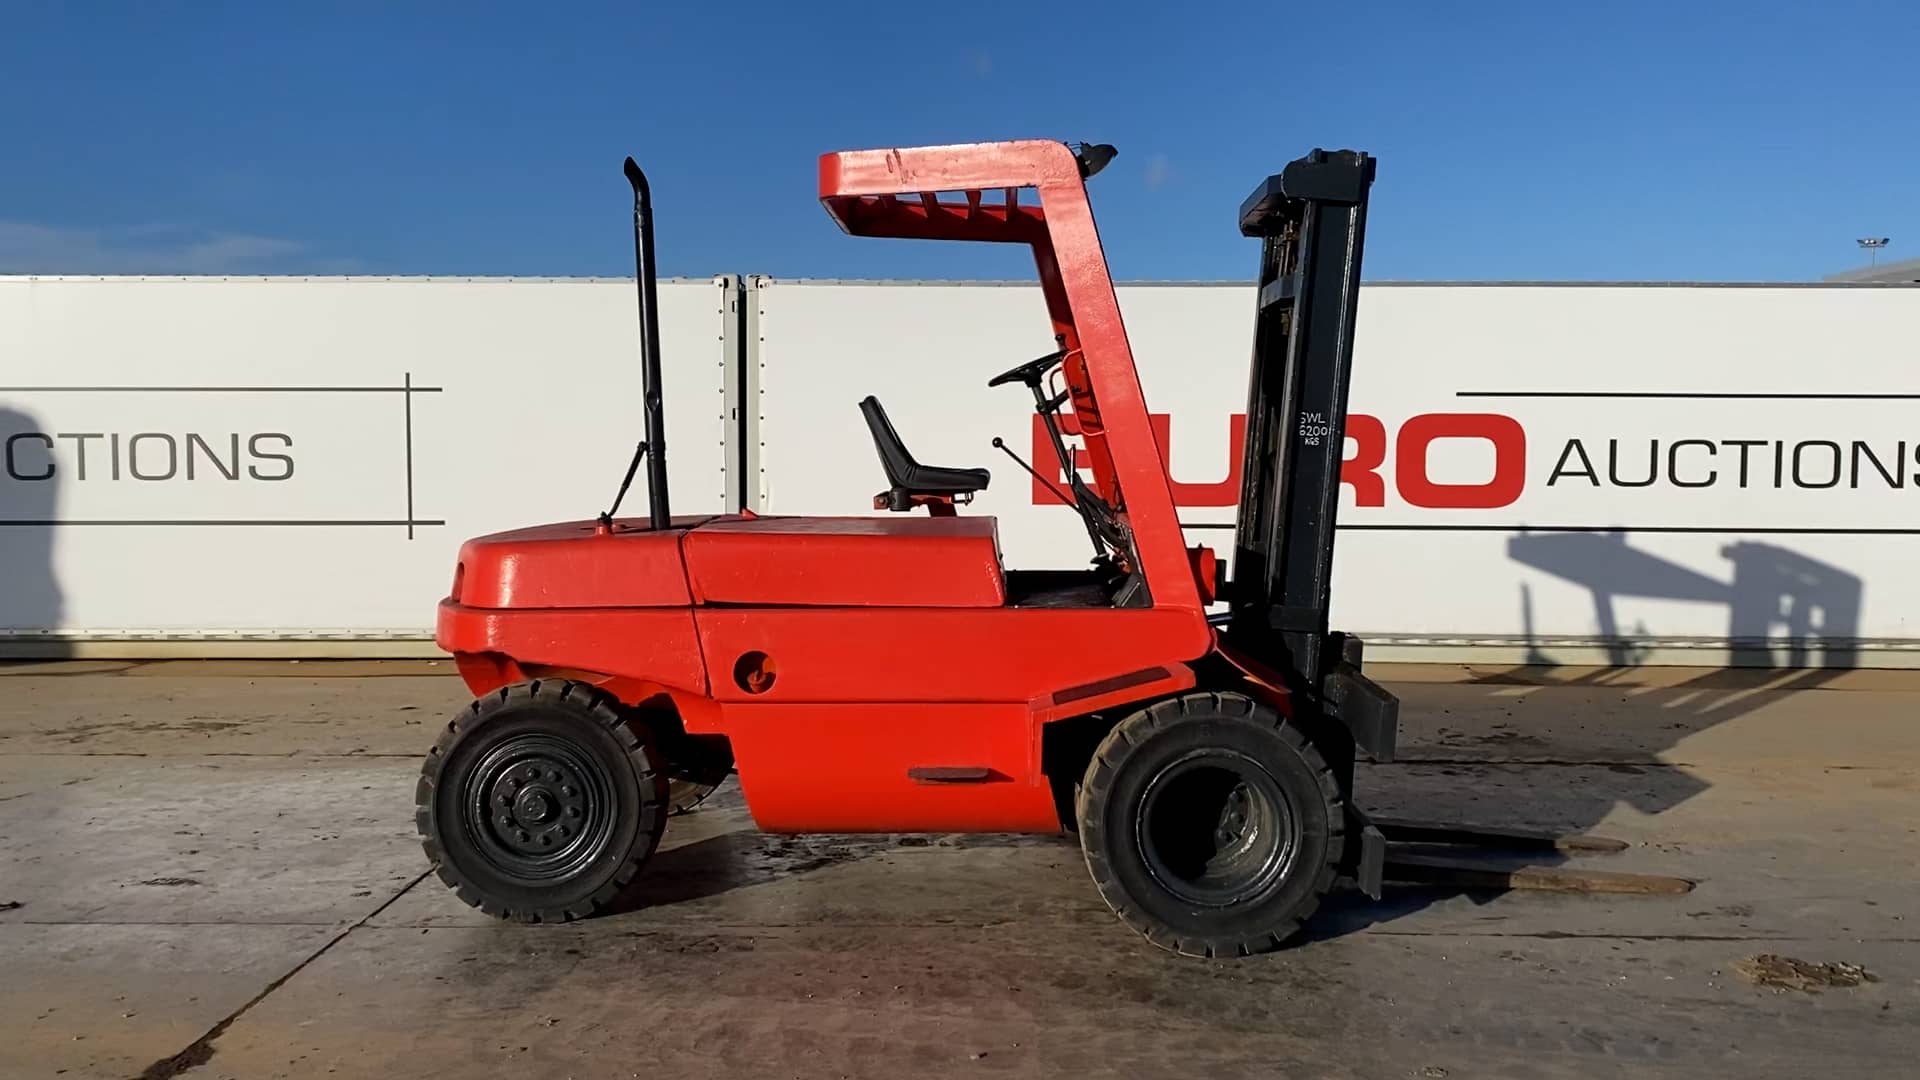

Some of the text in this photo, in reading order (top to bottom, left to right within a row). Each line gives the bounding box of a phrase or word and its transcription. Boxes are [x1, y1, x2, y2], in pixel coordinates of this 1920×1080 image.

[1299, 424, 1328, 437] 6200
[1300, 411, 1326, 424] SWL
[5, 432, 295, 481] CTIONS
[1546, 438, 1920, 489] AUCTION
